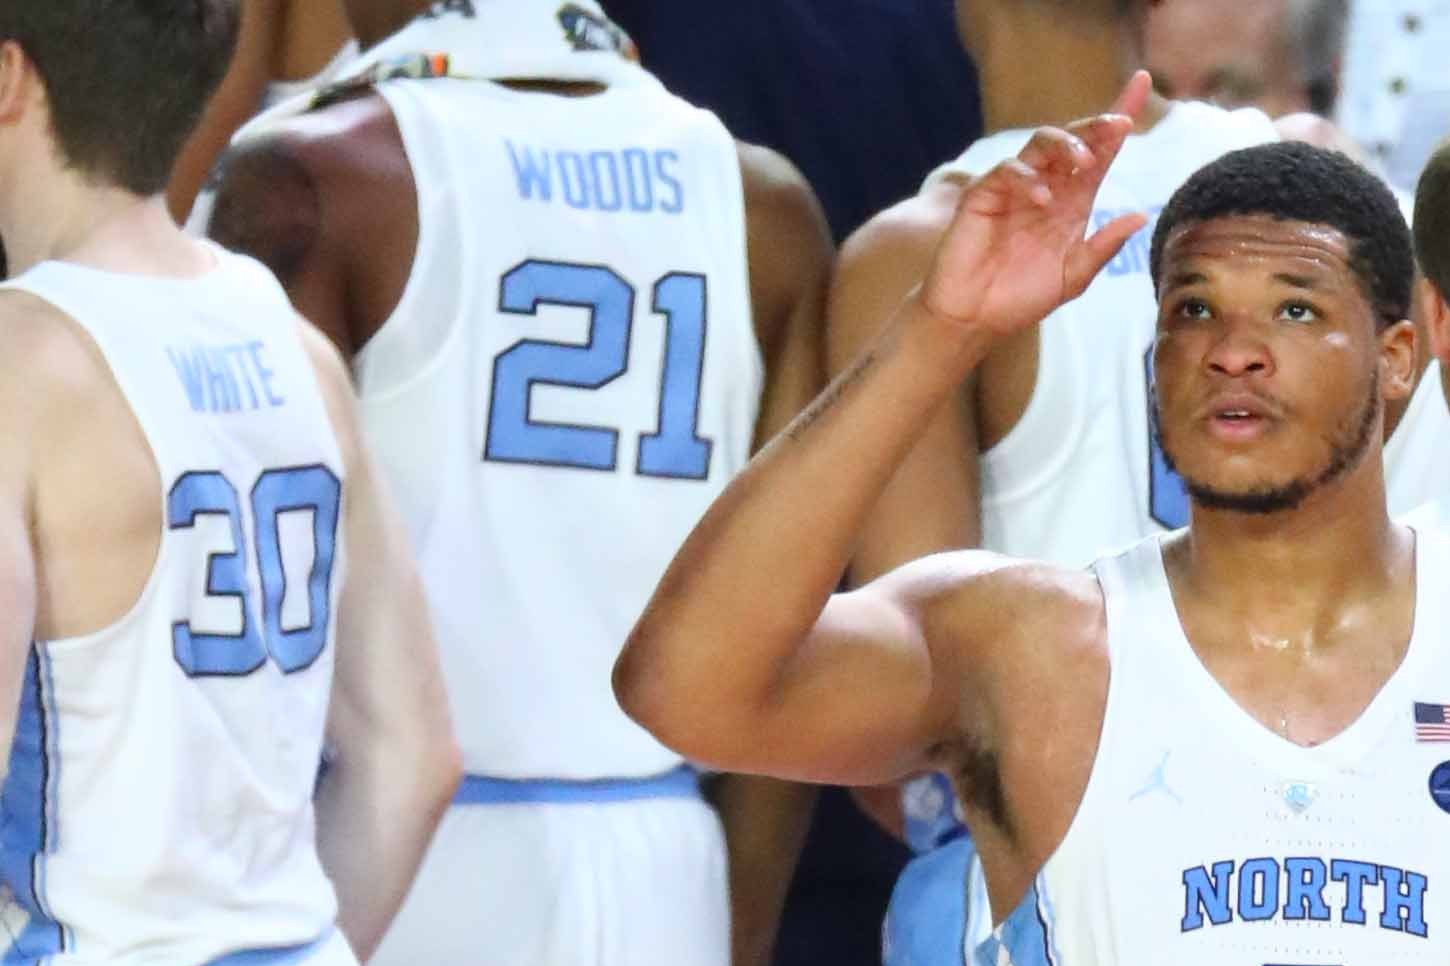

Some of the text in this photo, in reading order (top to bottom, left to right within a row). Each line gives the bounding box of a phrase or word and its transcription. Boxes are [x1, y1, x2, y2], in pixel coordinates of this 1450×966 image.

[505, 140, 684, 214] WOODS
[165, 340, 285, 412] WHITE
[483, 258, 713, 481] 21
[167, 463, 342, 678] 30
[1181, 856, 1429, 938] NORTH
